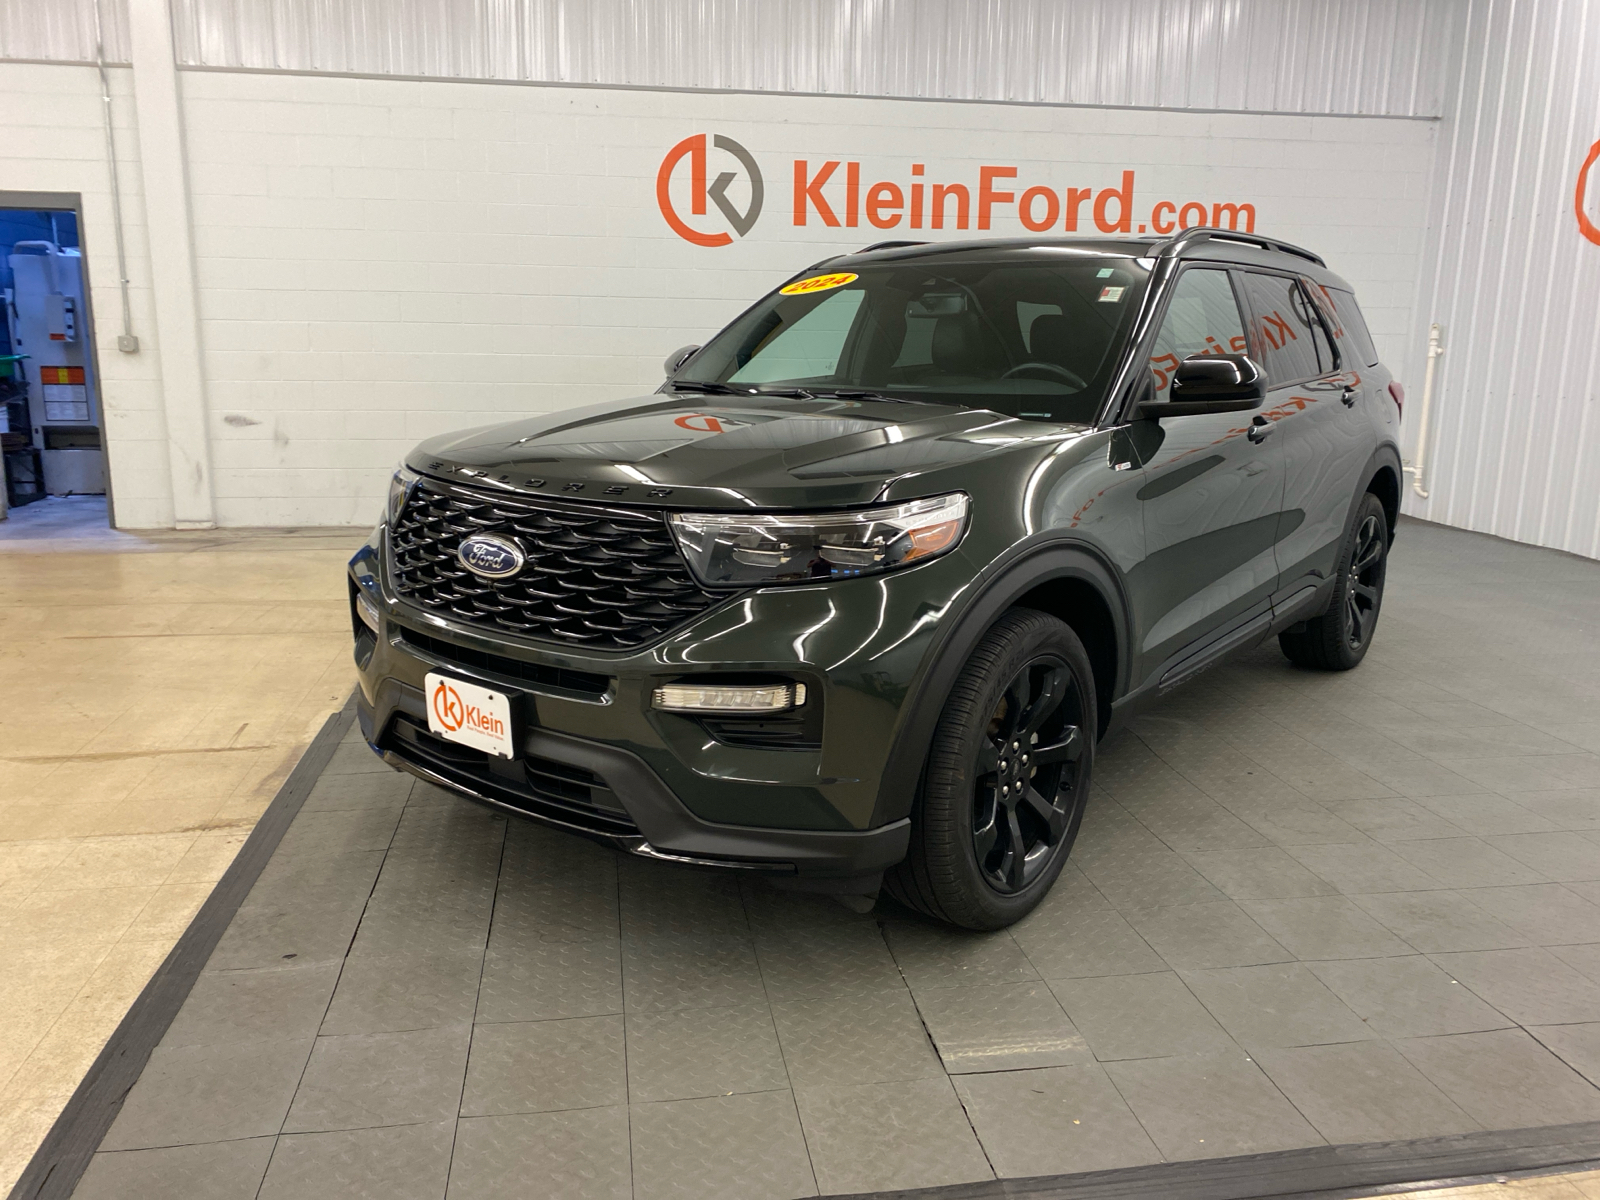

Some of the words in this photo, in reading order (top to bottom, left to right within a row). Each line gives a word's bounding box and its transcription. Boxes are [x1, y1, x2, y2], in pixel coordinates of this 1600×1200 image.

[793, 159, 1256, 235] KleinFord.com
[786, 274, 853, 293] 2024
[427, 461, 673, 498] EXPLORER
[468, 542, 505, 570] Ford
[466, 704, 504, 736] Klein
